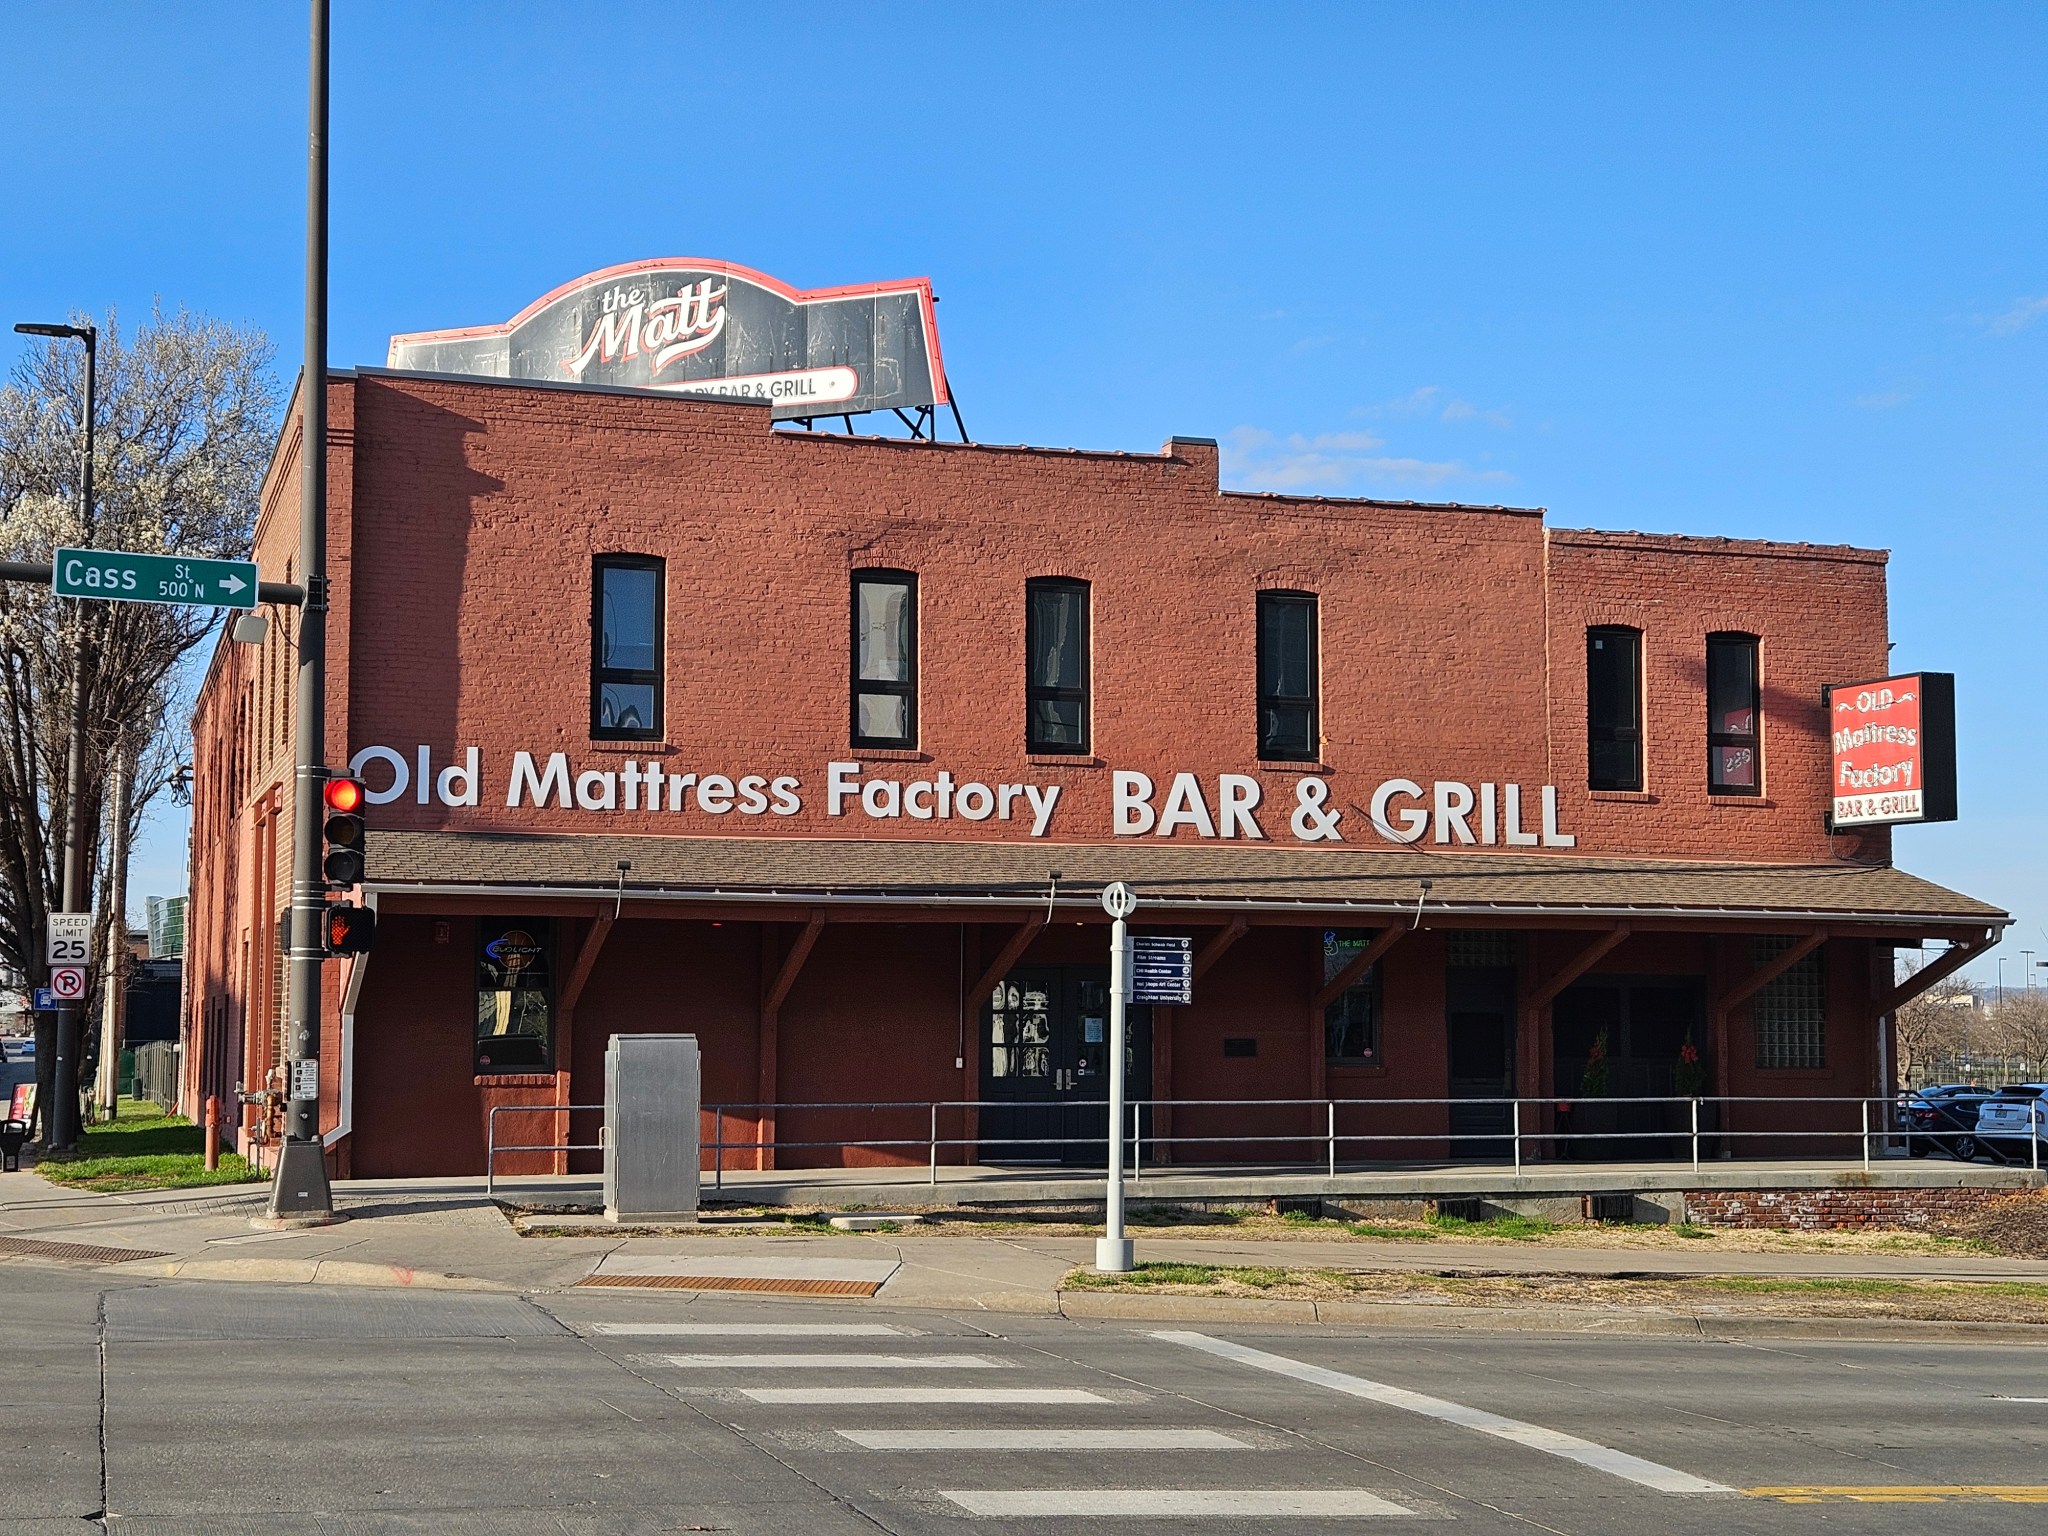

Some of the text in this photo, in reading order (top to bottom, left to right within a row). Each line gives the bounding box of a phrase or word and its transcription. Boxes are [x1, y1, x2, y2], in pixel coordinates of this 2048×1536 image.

[602, 285, 645, 314] the
[565, 277, 727, 375] Matt
[770, 378, 817, 398] GRILL
[65, 559, 191, 590] Cass St
[159, 581, 204, 599] 500 N
[1856, 688, 1894, 713] OLD
[1833, 721, 1918, 756] Mattress
[1838, 757, 1915, 789] Factory
[348, 744, 1576, 848] Old Mattress Factory BAR & GRILL
[1837, 794, 1920, 819] BAR & GRILL
[52, 918, 88, 926] SPEED
[52, 940, 86, 959] 25
[1338, 939, 1350, 947] THE
